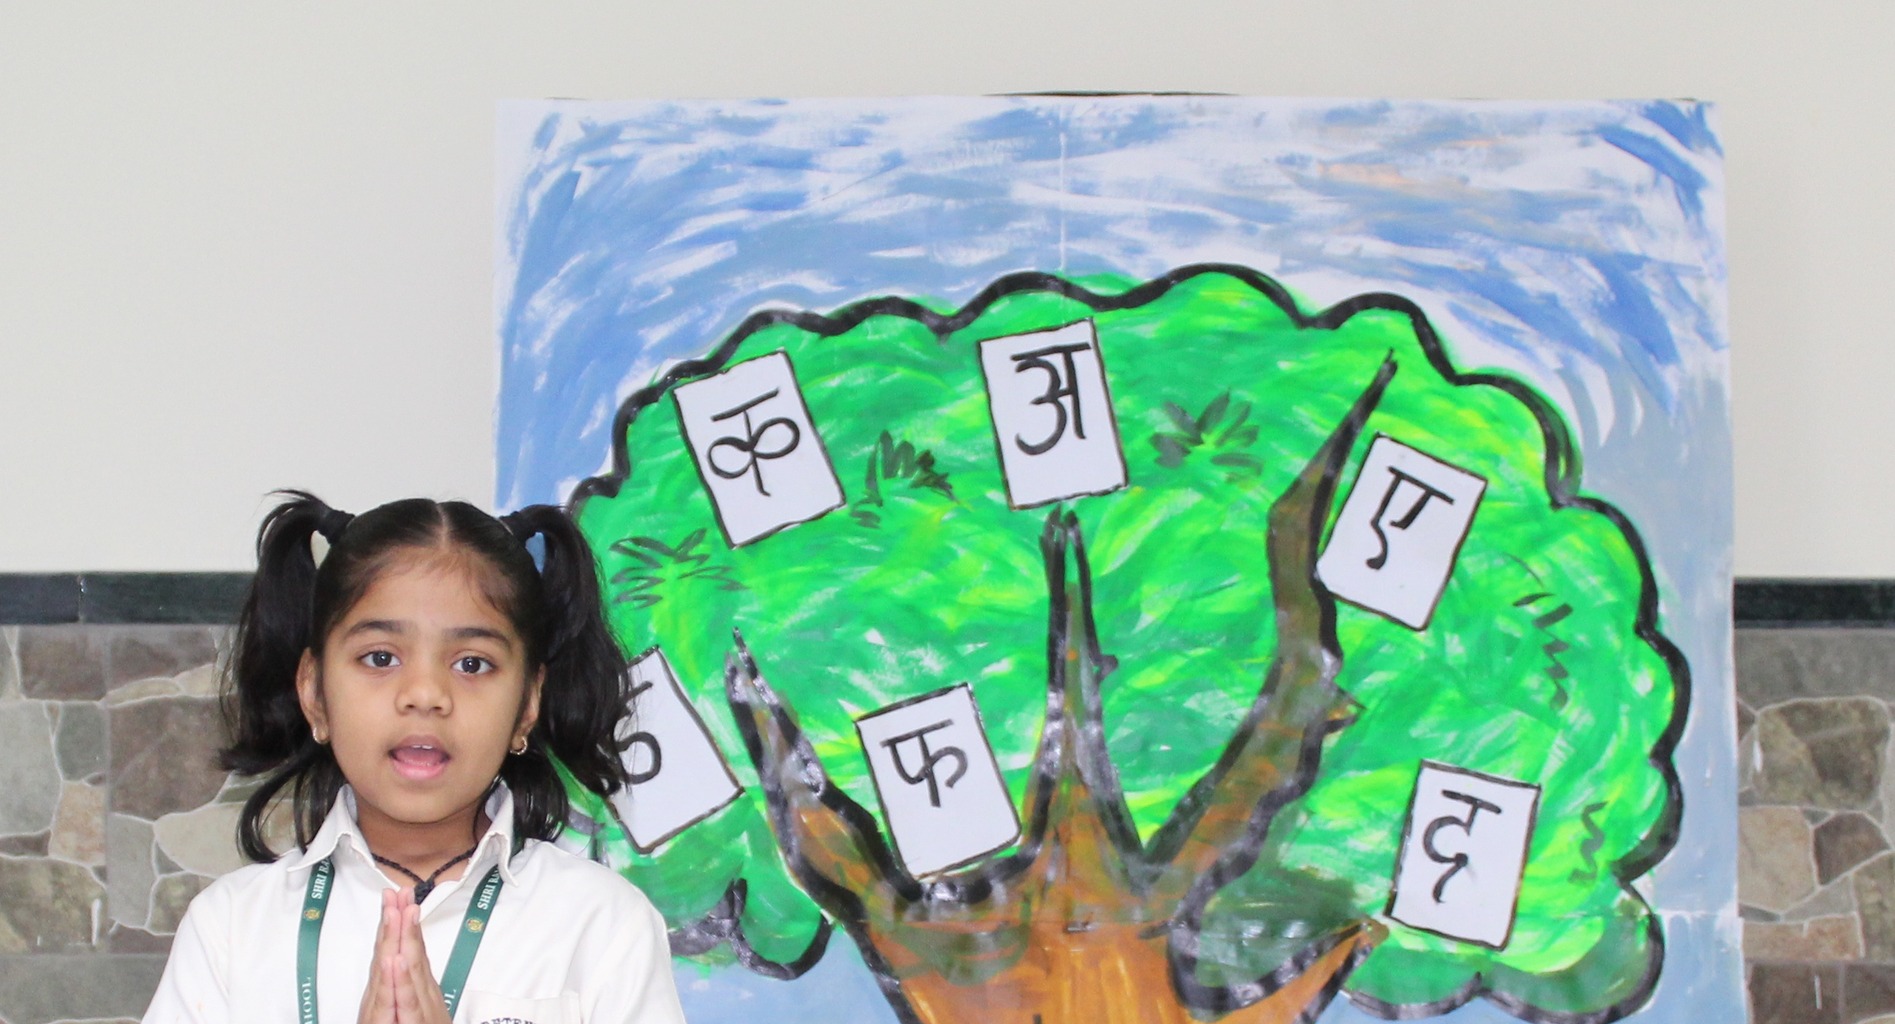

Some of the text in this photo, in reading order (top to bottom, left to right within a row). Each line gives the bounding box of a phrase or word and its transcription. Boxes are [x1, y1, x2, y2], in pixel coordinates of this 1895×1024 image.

[708, 389, 800, 497] क
[1011, 343, 1091, 456] अ
[1366, 466, 1455, 570] ए
[882, 721, 968, 808] फ
[311, 873, 328, 899] SHRI
[477, 884, 497, 910] SHRI
